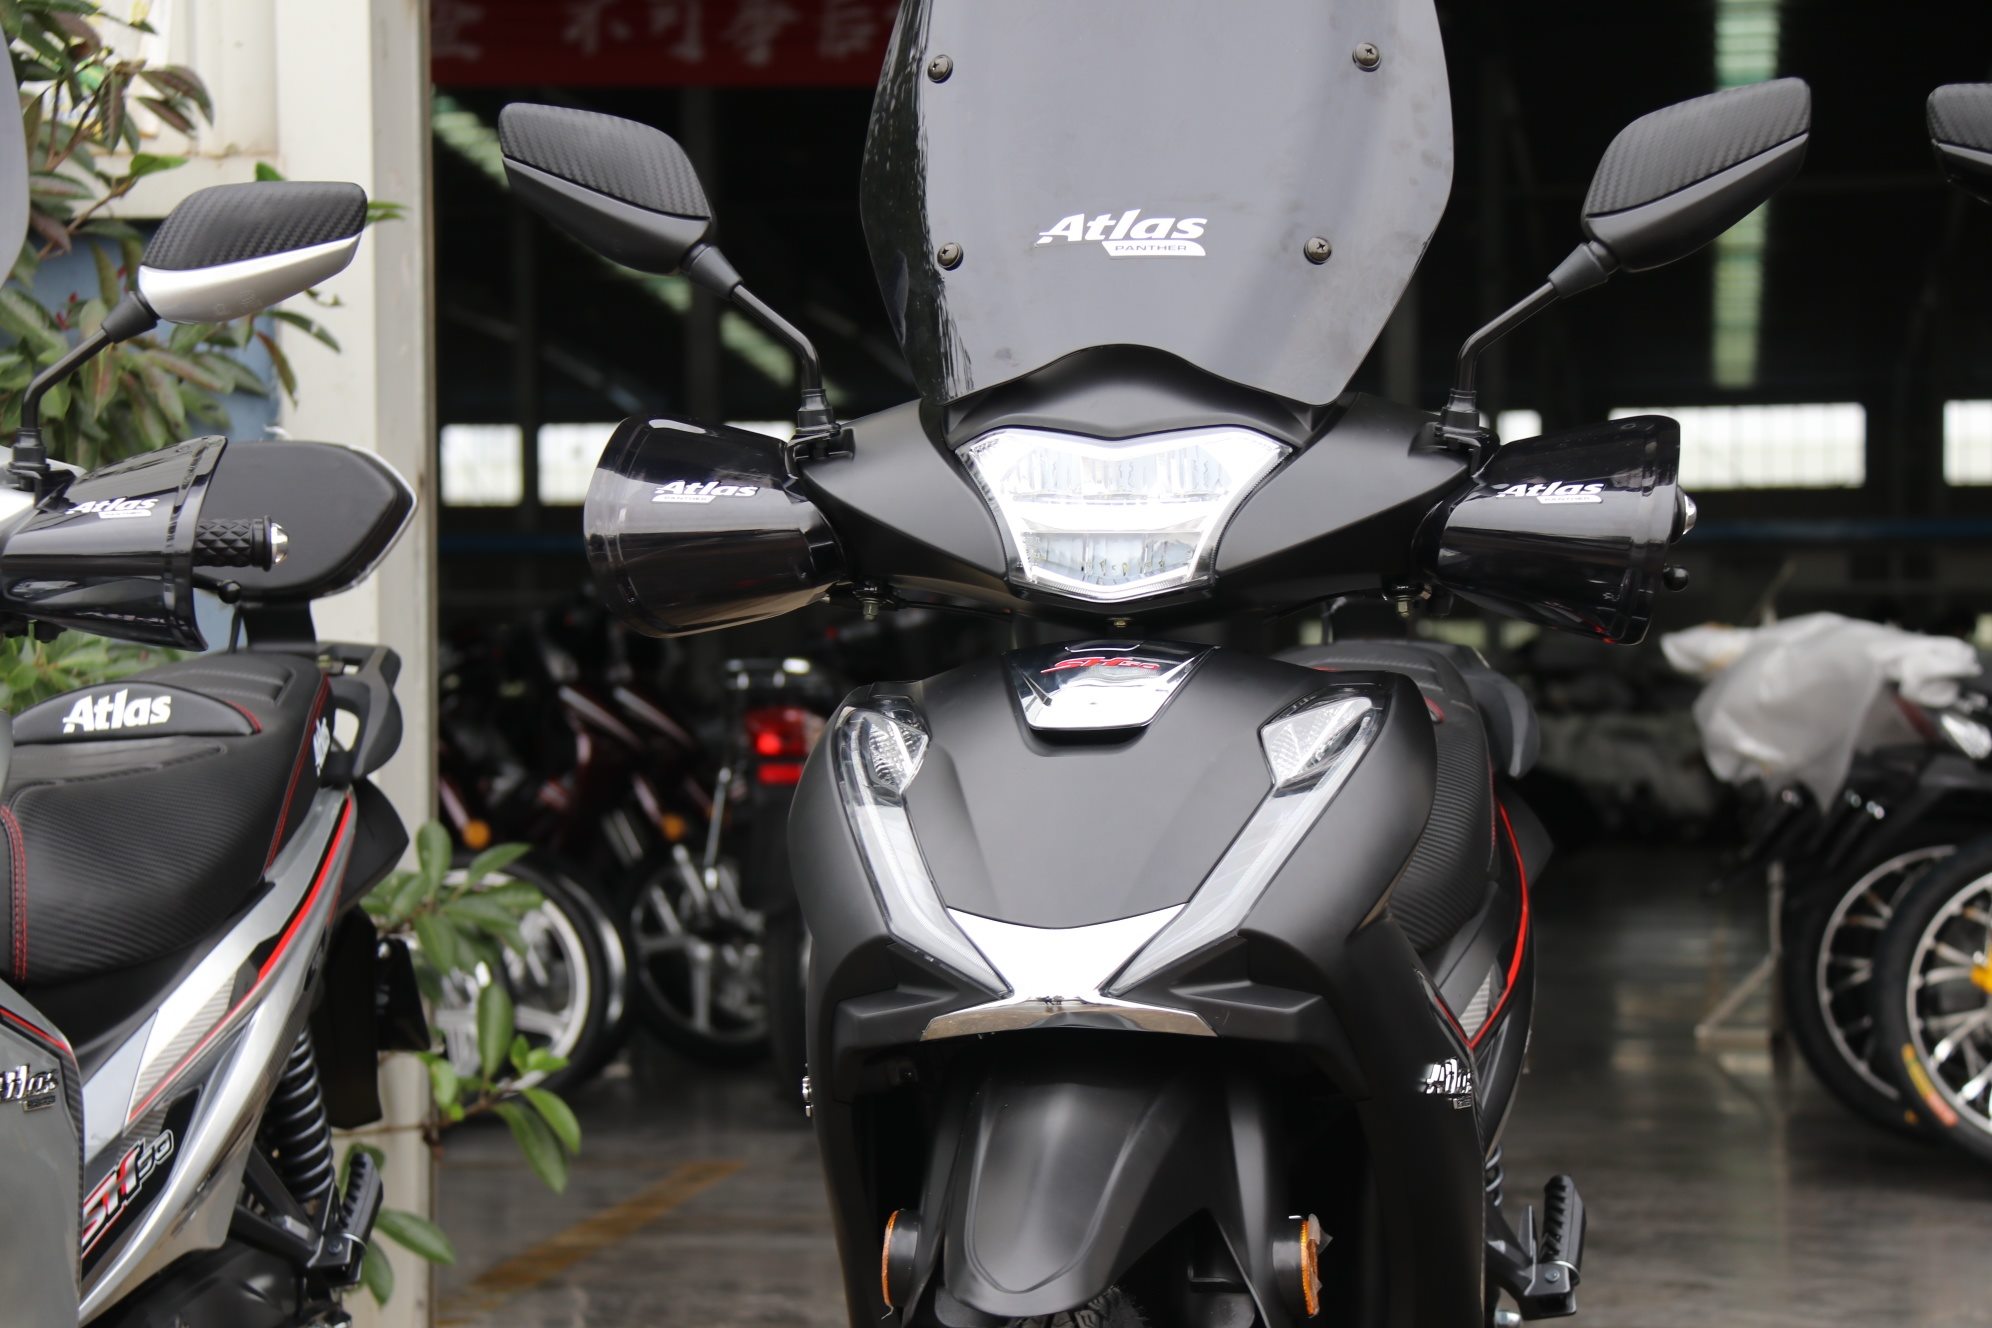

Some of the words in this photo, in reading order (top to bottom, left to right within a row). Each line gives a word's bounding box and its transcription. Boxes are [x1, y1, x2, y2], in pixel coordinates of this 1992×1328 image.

[1036, 209, 1208, 243] Atlas
[654, 480, 759, 496] Atlas
[1496, 481, 1604, 497] Atlas
[65, 498, 159, 514] Atlas
[62, 688, 171, 733] Atlas
[0, 1064, 58, 1100] tlas
